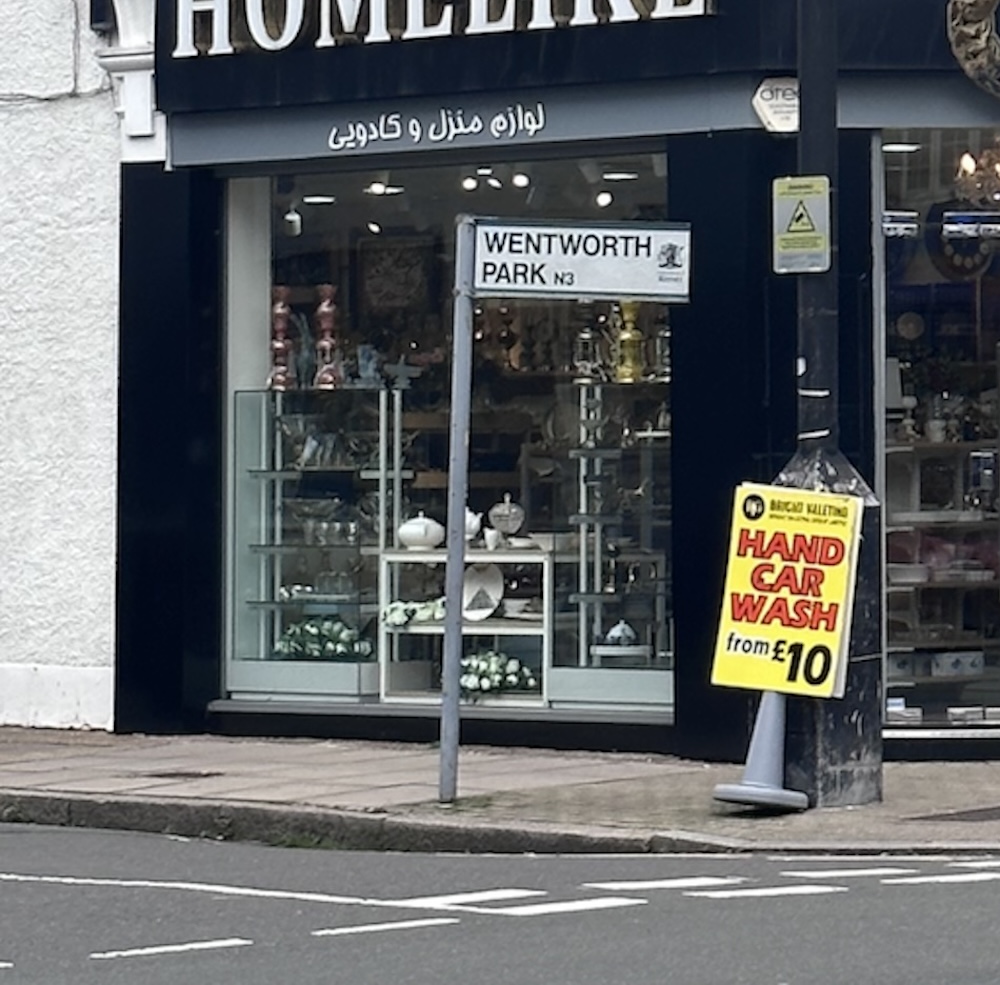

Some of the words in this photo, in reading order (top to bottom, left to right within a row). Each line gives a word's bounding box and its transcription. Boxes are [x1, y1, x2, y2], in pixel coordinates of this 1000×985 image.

[760, 87, 800, 102] are
[408, 117, 423, 143] و
[428, 109, 484, 142] منزل
[489, 103, 546, 139] لوازم
[483, 232, 652, 257] WENTWORTH
[482, 262, 547, 285] PARK
[553, 273, 575, 286] N3
[737, 528, 845, 566] HAND
[751, 563, 826, 597] CAR
[731, 593, 839, 632] WASH
[727, 632, 770, 655] from
[772, 639, 833, 686] £10
